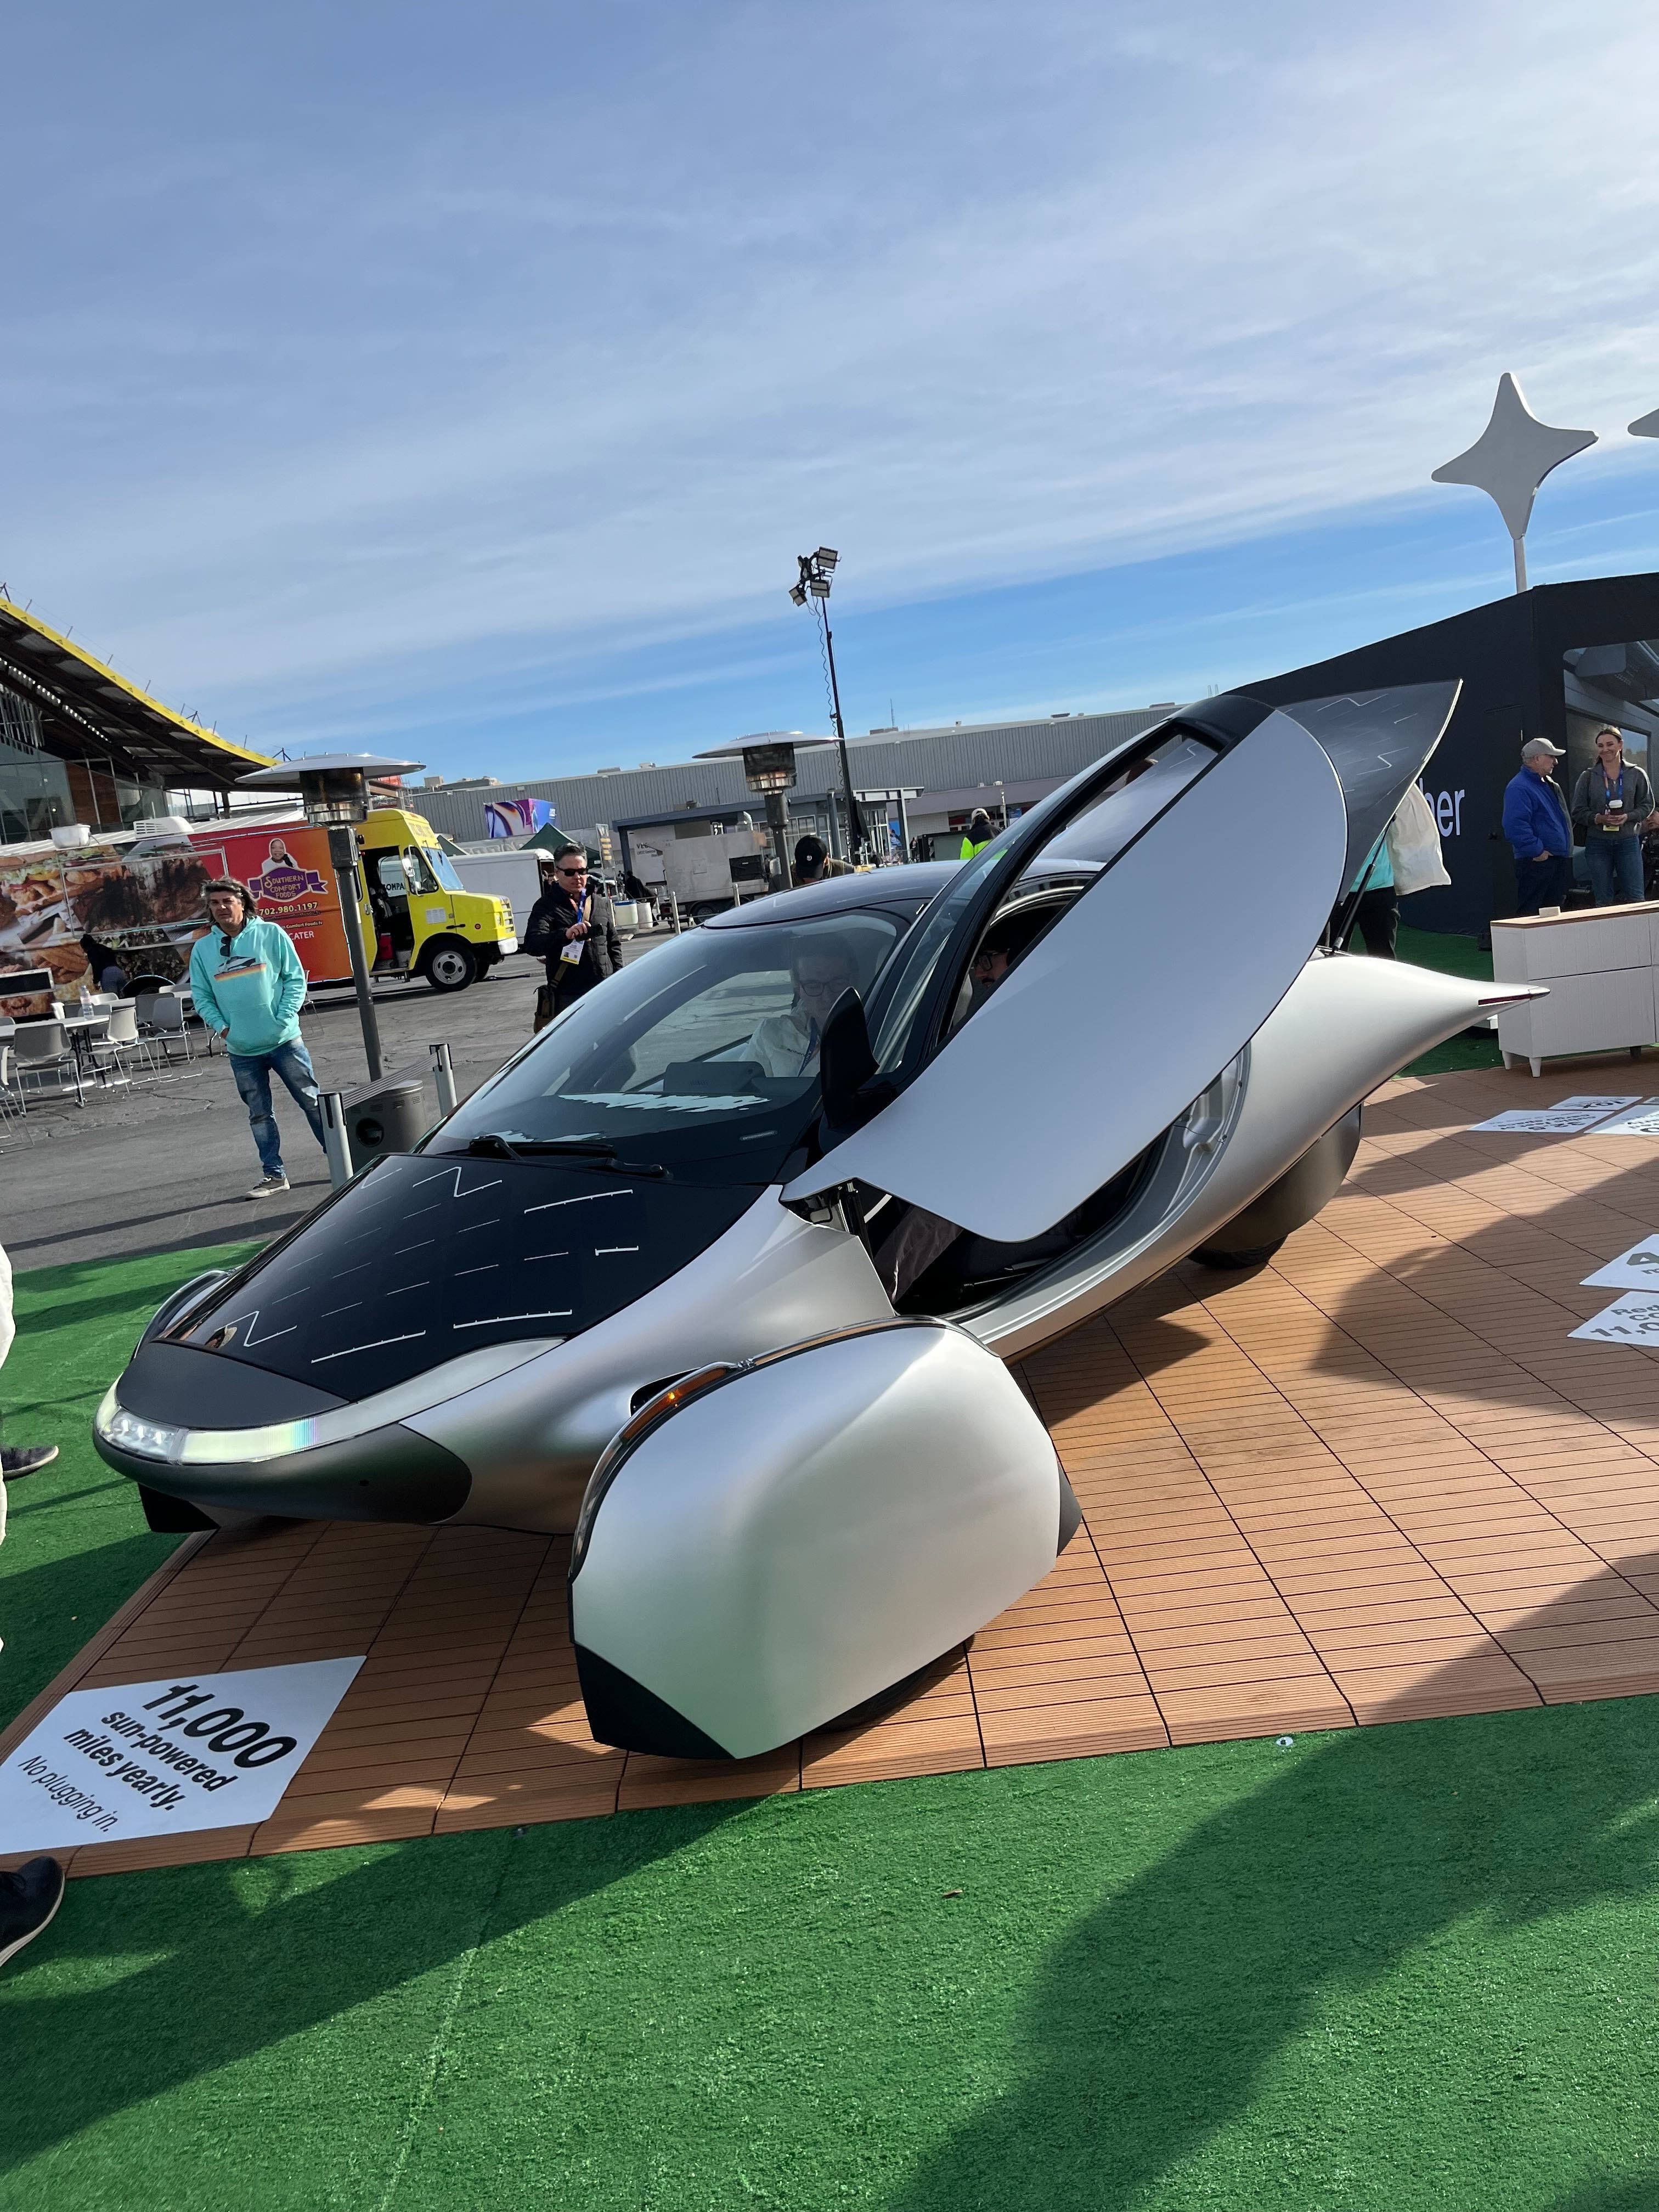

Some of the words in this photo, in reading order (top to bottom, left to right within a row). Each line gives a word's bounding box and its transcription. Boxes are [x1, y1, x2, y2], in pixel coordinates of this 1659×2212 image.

[264, 874, 304, 888] SOUTHERN
[270, 883, 302, 893] COMFORT
[259, 902, 318, 916] 702.980.1197
[142, 1684, 297, 1768] 11,000
[101, 1711, 239, 1792] sun-powered
[18, 1756, 47, 1775] No
[63, 1728, 124, 1767] miles
[105, 1760, 187, 1810] yearly.
[31, 1775, 105, 1820] plugging
[92, 1810, 118, 1832] in.
